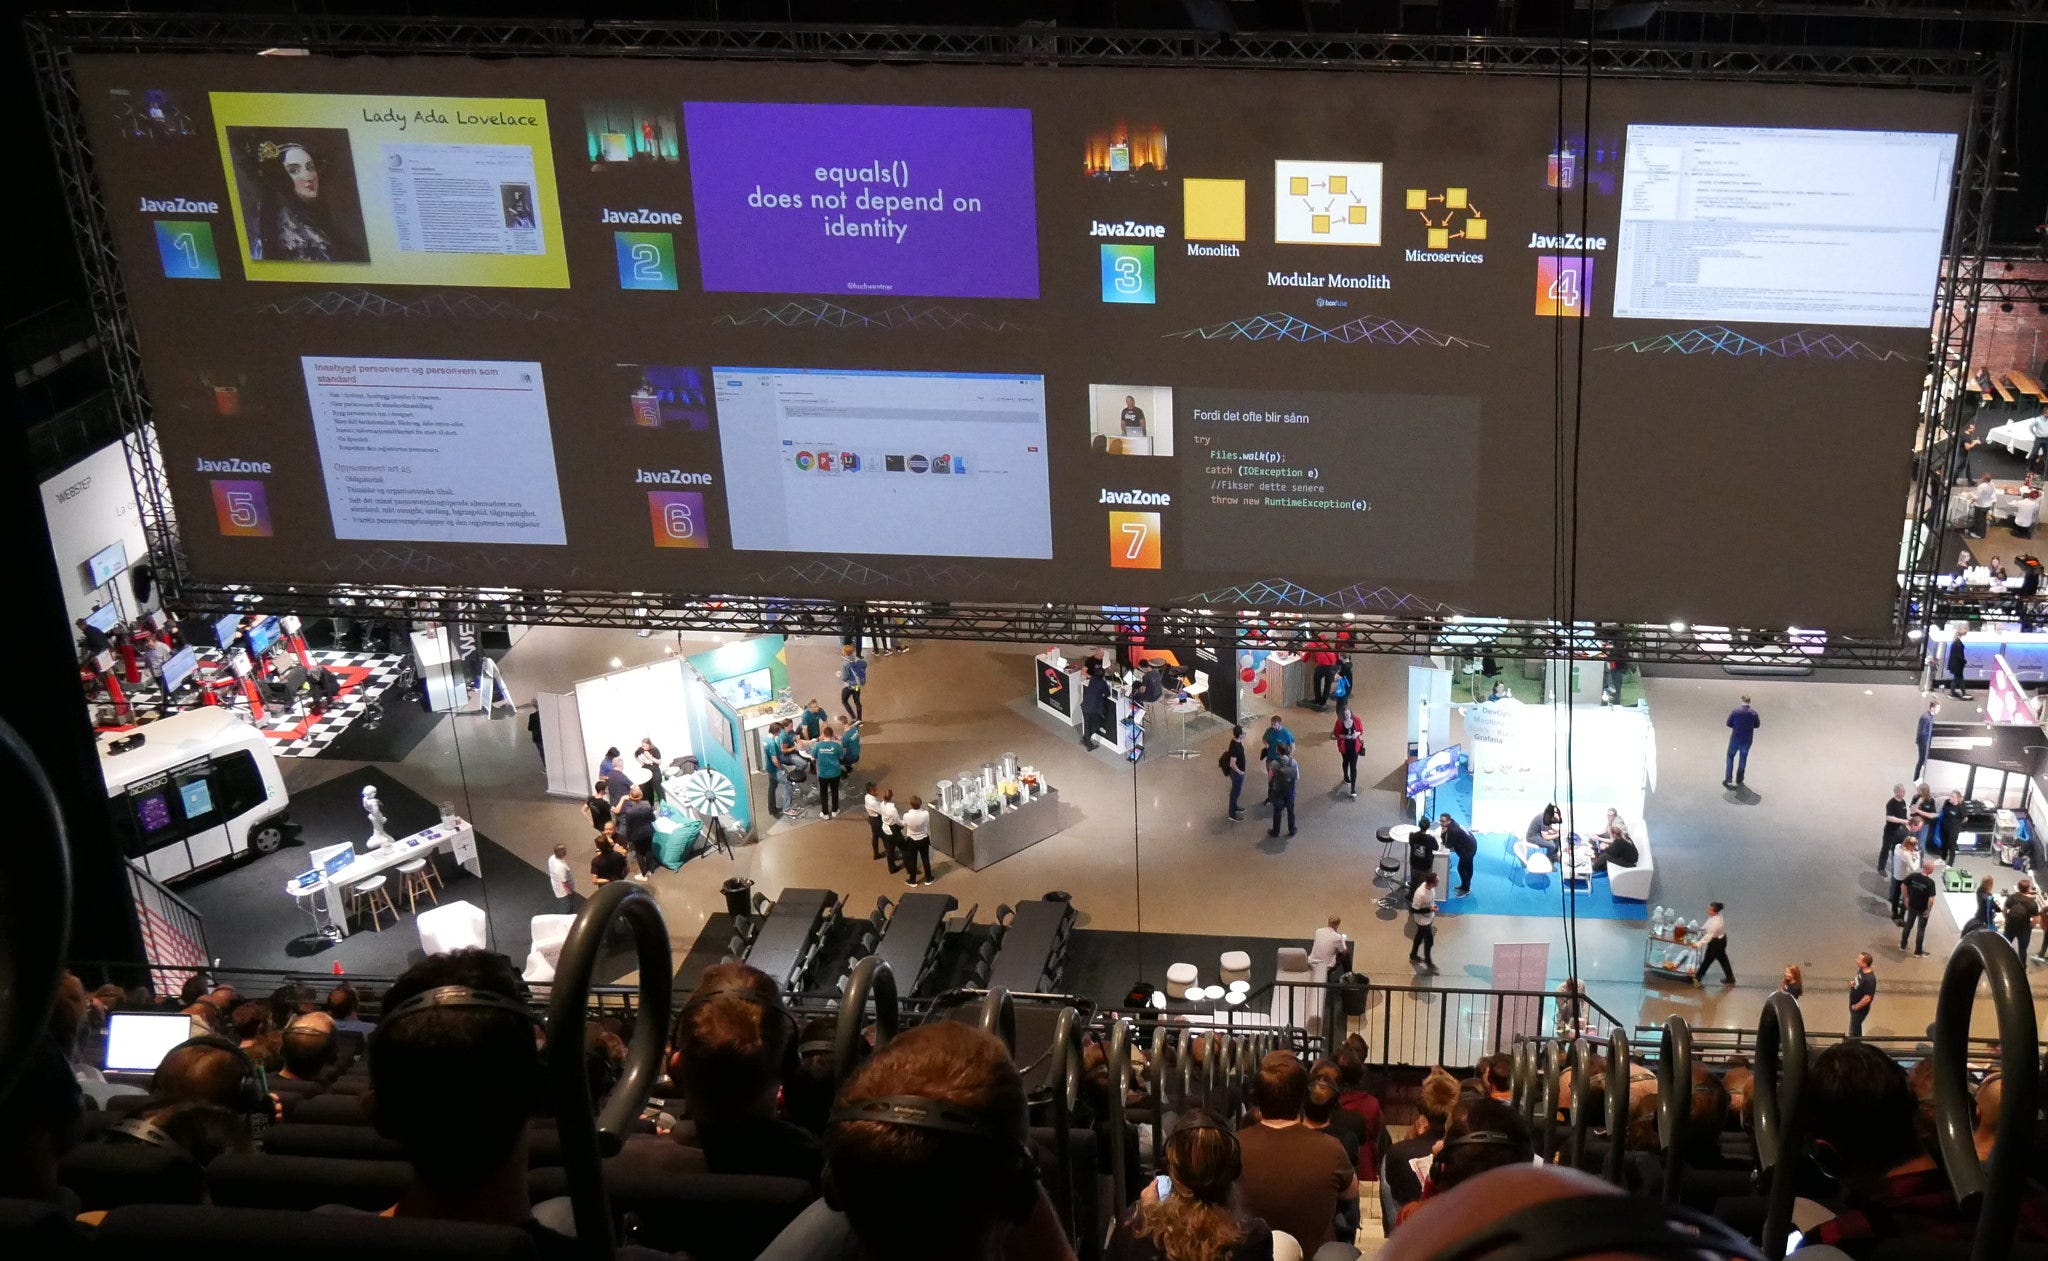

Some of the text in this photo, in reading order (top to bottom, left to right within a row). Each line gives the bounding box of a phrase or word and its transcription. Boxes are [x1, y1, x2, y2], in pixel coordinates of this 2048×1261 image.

[363, 108, 538, 130] Lady Ada Lovelace
[814, 160, 909, 188] equals()
[140, 196, 219, 214] JavaZone
[747, 185, 982, 216] does not depend on
[602, 208, 682, 226] JavaZone
[824, 215, 908, 244] identity
[1090, 220, 1166, 238] JavaZone
[1187, 243, 1240, 258] Monolith
[1528, 232, 1606, 251] JavaZone
[173, 232, 200, 270] 1
[1405, 249, 1484, 264] Microservices
[631, 243, 662, 280] 2
[1114, 256, 1142, 294] 3
[1267, 272, 1391, 290] Modular Monolith
[1548, 270, 1579, 306] 4
[1194, 409, 1220, 421] Fordi
[1223, 410, 1241, 422] det
[1242, 410, 1263, 422] ofte
[1265, 411, 1282, 423] blir
[1194, 434, 1211, 446] try
[196, 458, 272, 474] JavaZone
[1210, 450, 1286, 464] Files.walk(p);
[635, 468, 712, 486] JavaZone
[1205, 464, 1319, 479] catch (IOException e)
[56, 476, 92, 504] WEBSTEP
[1210, 479, 1325, 493] //Fikser dette senere
[1099, 488, 1171, 506] JavaZone
[1210, 494, 1372, 512] throw new RuntimeException(e);
[227, 492, 258, 527] 5
[664, 503, 694, 538] 6
[1122, 522, 1148, 560] 7
[1474, 734, 1504, 744] Grafana
